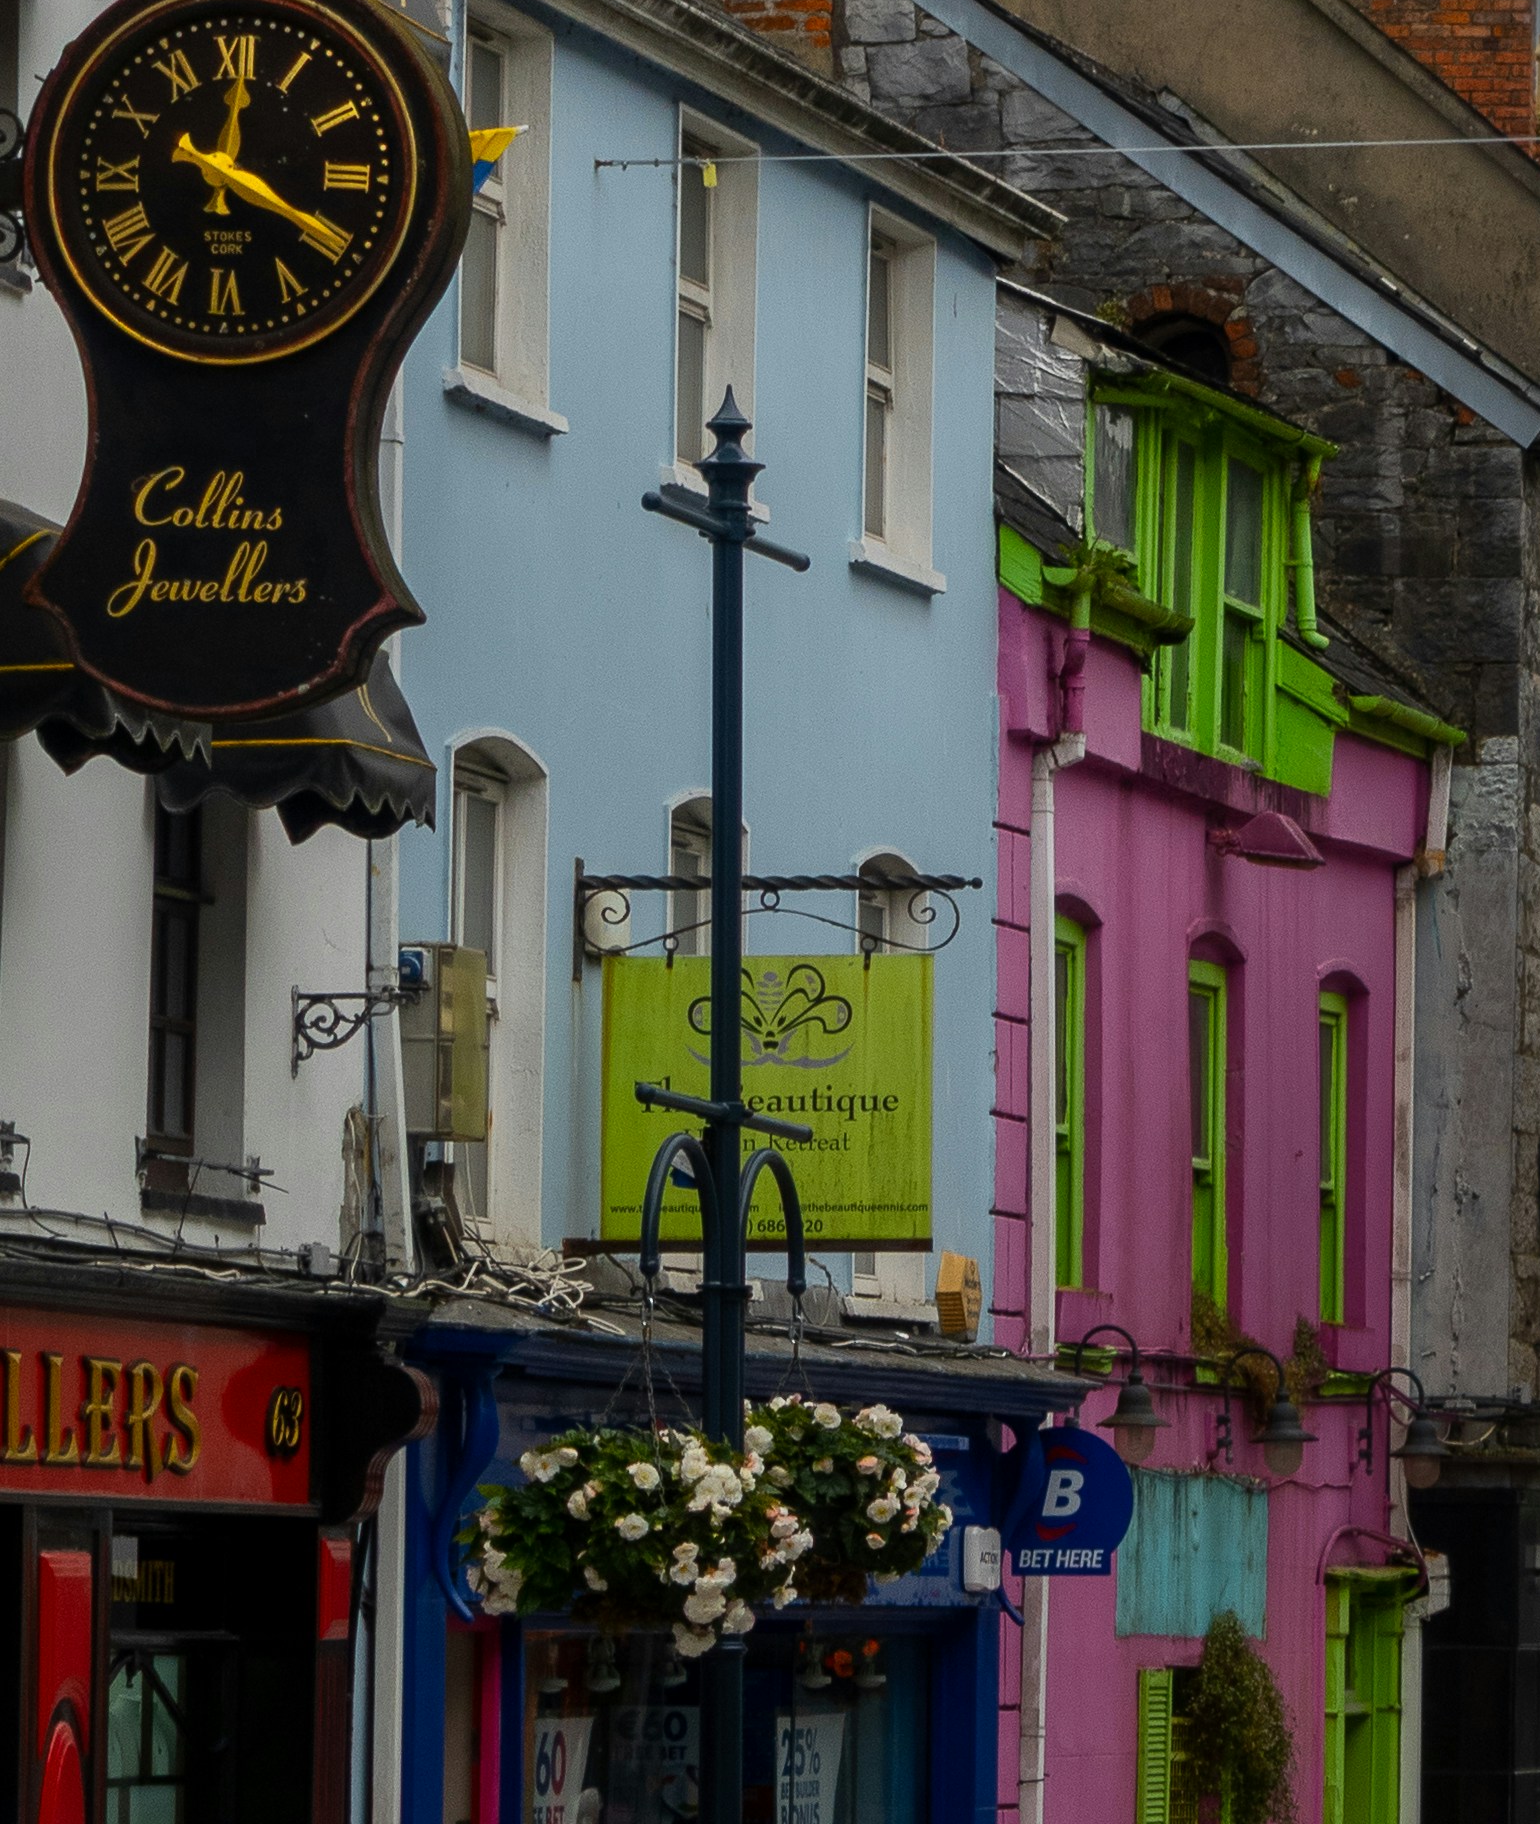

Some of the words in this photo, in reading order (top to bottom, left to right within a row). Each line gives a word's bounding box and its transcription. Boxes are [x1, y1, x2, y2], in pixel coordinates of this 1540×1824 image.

[152, 49, 202, 104] XI
[213, 34, 257, 81] XII
[112, 93, 160, 140] X
[310, 99, 360, 138] II
[96, 154, 140, 193] IX
[323, 160, 371, 194] III
[101, 201, 157, 267] VIII
[203, 230, 253, 243] STOKES
[210, 243, 244, 255] CORK
[141, 245, 190, 306] VII
[208, 267, 246, 316] VI
[274, 255, 308, 304] V
[132, 465, 283, 531] Collins
[106, 537, 308, 618] Jewellers
[271, 1387, 303, 1449] 63
[1041, 1468, 1085, 1517] B
[1018, 1549, 1054, 1569] BET
[1055, 1549, 1104, 1569] HERE
